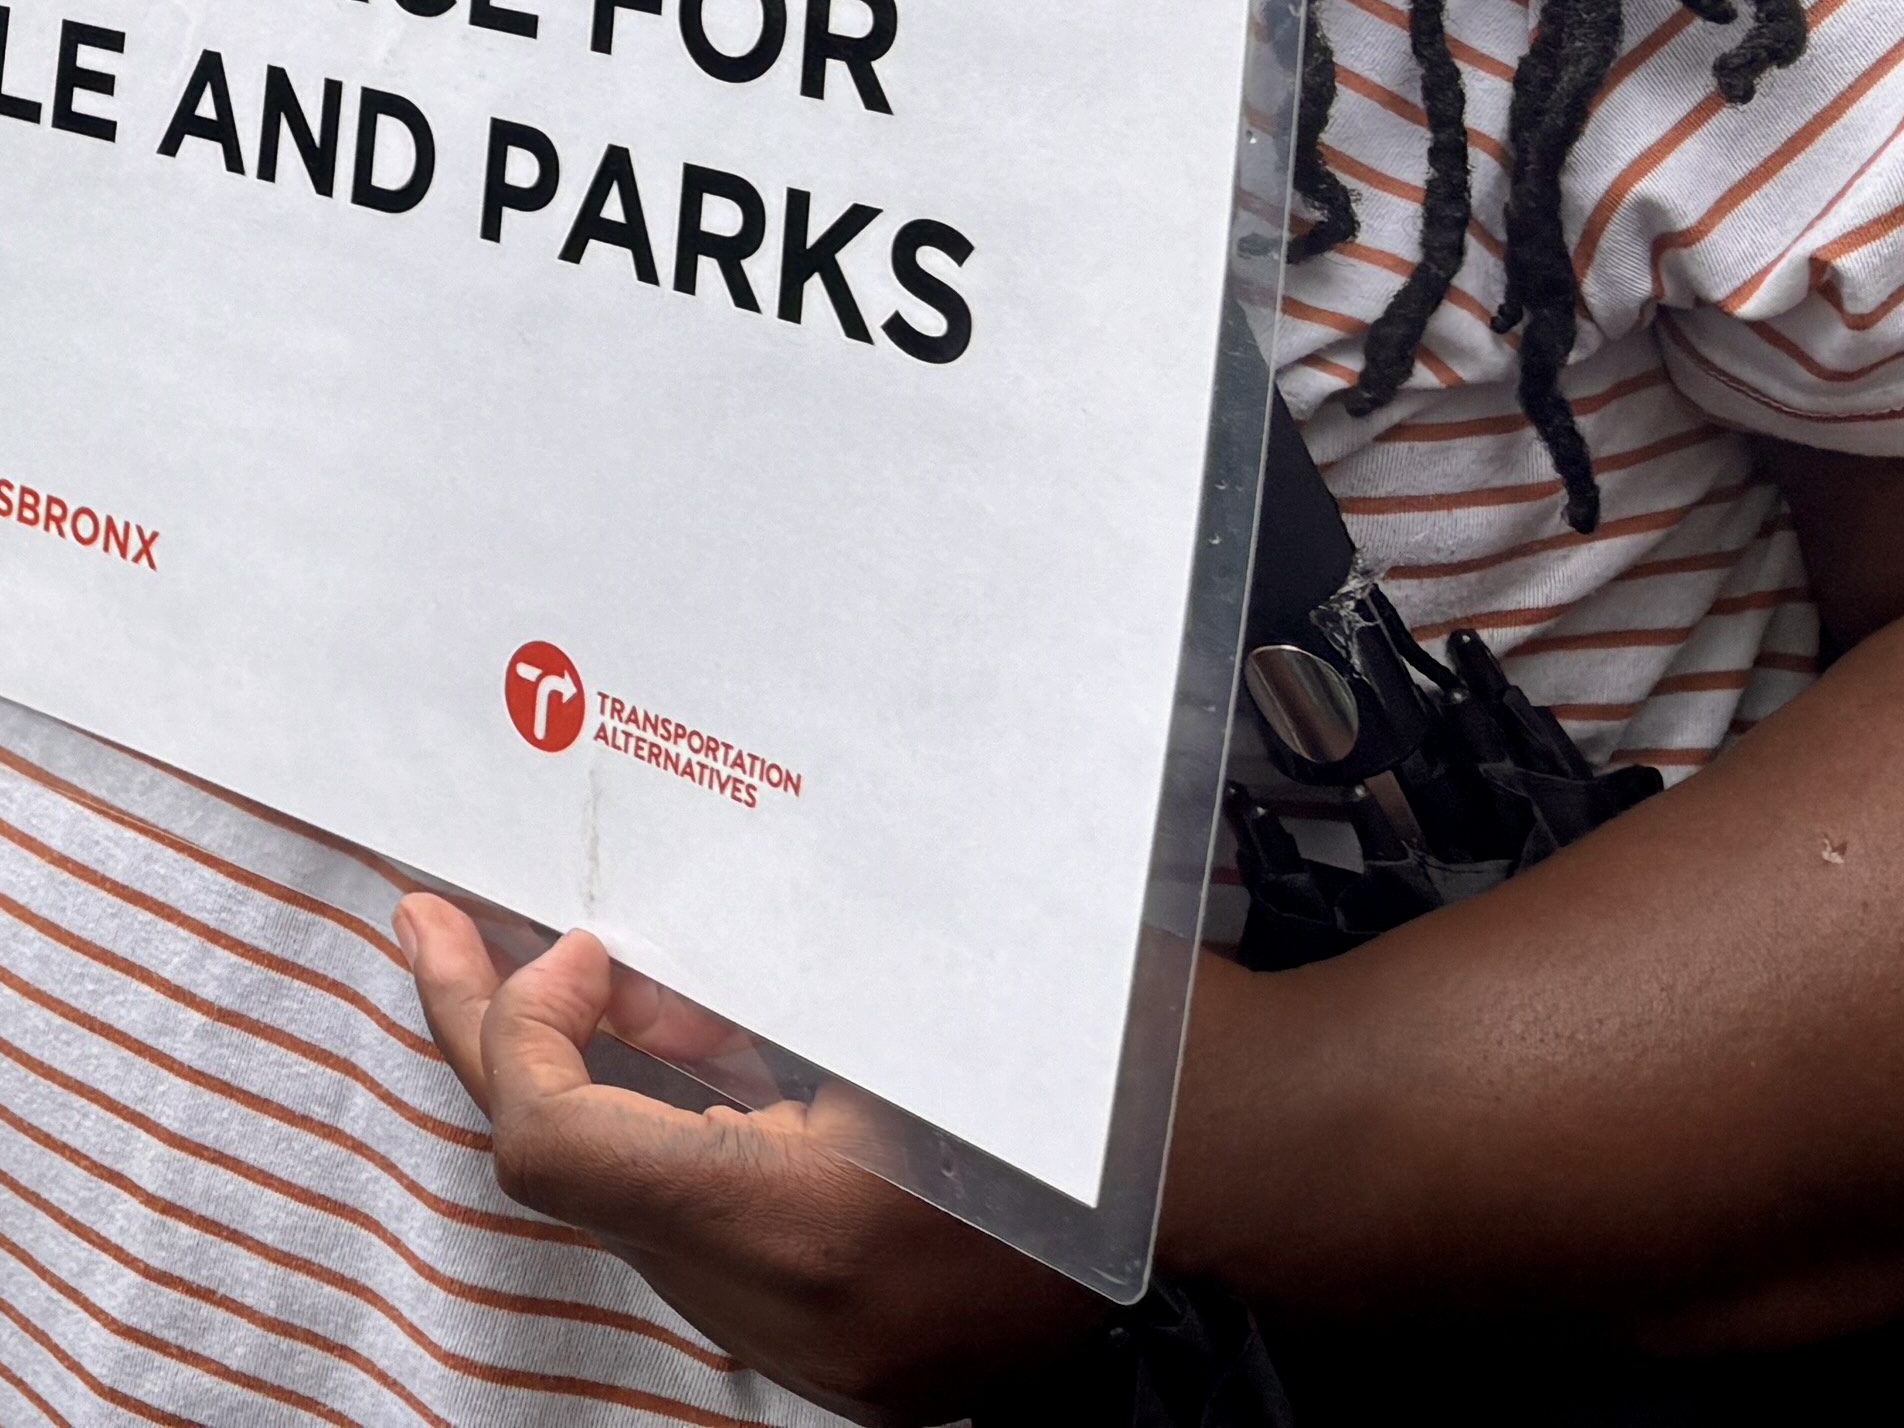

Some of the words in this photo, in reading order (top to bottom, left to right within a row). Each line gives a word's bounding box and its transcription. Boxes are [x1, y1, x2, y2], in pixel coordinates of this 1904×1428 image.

[155, 50, 437, 215] AND
[479, 115, 976, 366] PARKS
[593, 721, 759, 809] ALTERNATIVES
[596, 690, 803, 798] TRANSPORTATION
